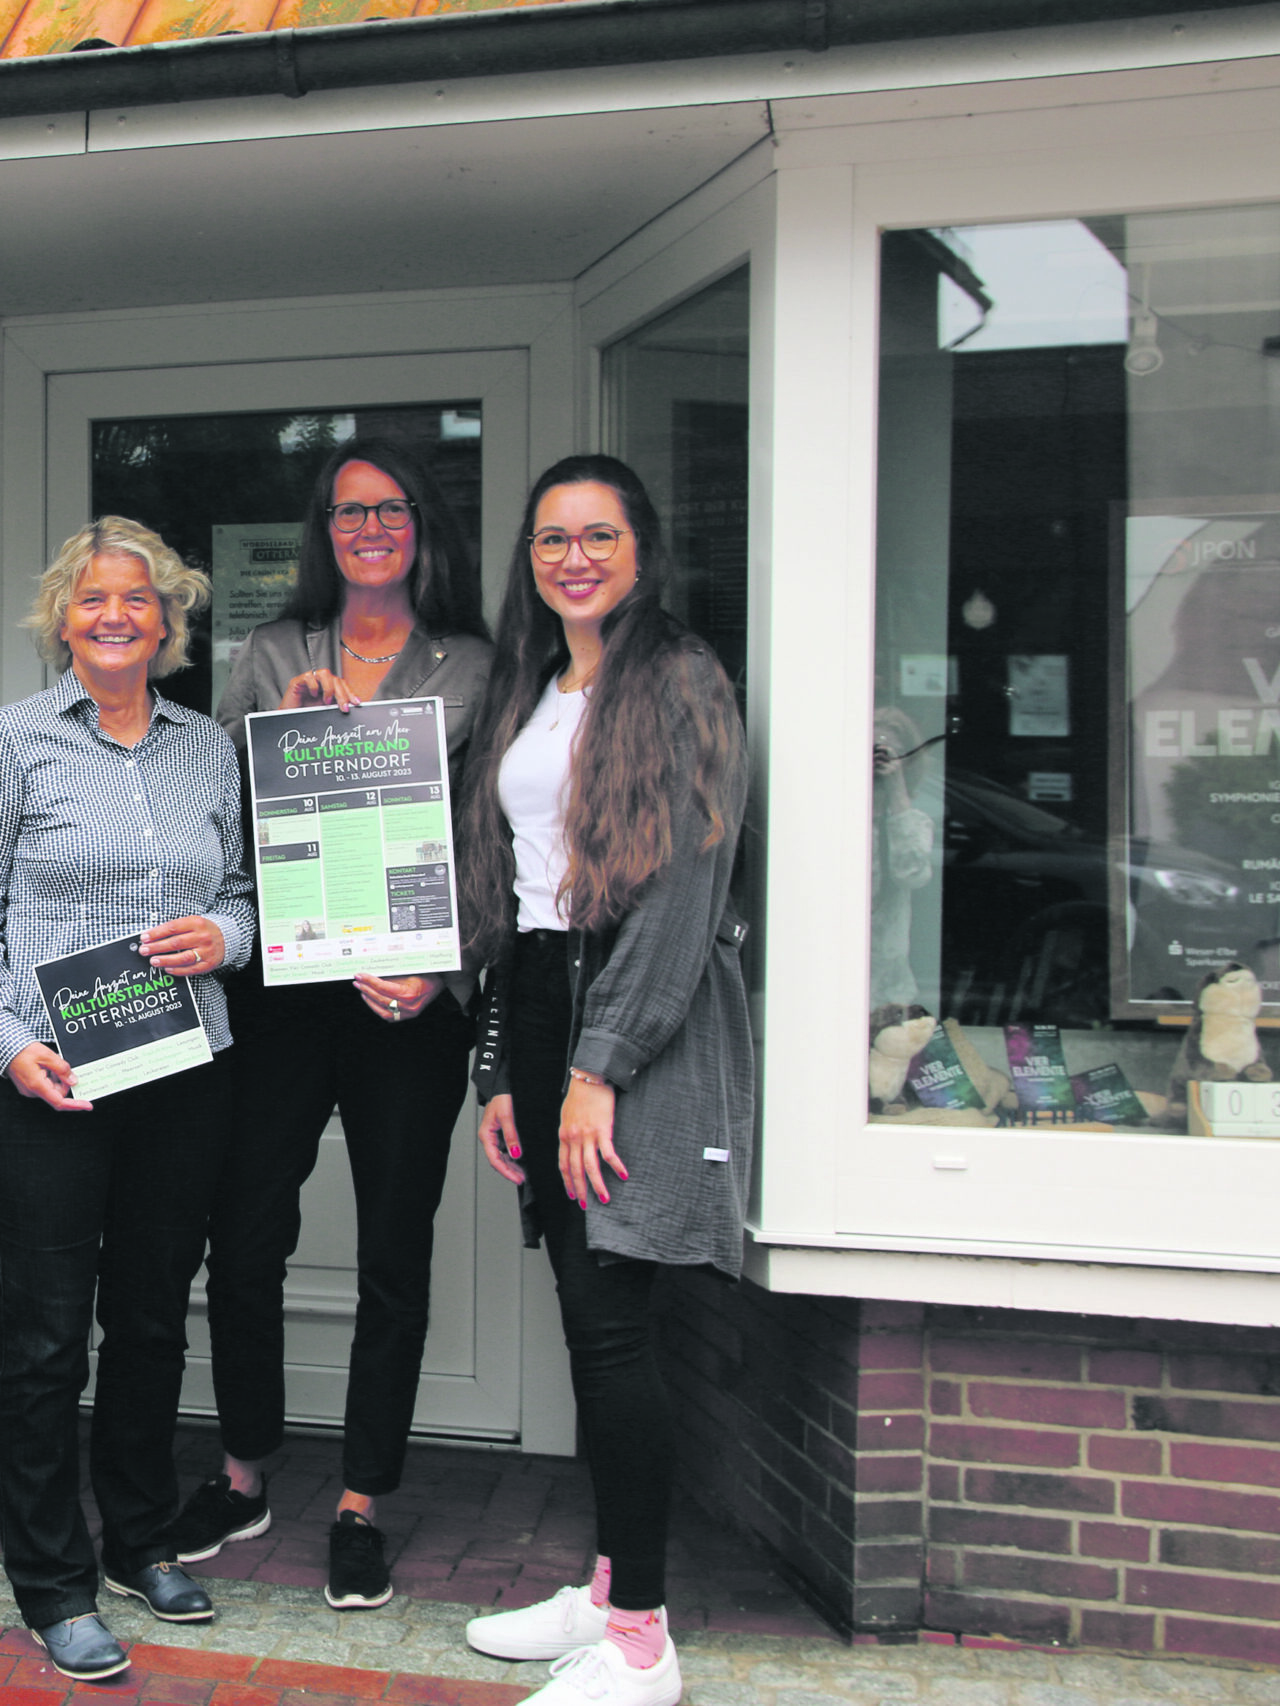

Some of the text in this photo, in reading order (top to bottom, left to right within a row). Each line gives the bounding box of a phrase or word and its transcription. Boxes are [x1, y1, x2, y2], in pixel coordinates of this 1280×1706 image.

[229, 590, 254, 598] Sollten
[256, 590, 268, 598] Sie
[278, 728, 318, 754] Deine
[320, 724, 365, 750] Auszeit
[284, 738, 410, 764] KULTURSTRAND
[285, 753, 412, 779] OTTERNDORF
[336, 774, 346, 782] 10.
[351, 772, 360, 780] 13.
[362, 769, 392, 780] AUGUST
[393, 768, 412, 777] 2023
[366, 792, 376, 800] 12
[429, 786, 440, 794] 13
[303, 799, 314, 807] 10
[259, 808, 298, 817] DONNERSTAG
[307, 844, 317, 852] 11
[52, 986, 90, 1010] Deine
[93, 970, 131, 1000] Auszeit
[60, 974, 174, 1020] KULTURSTRAND
[65, 987, 179, 1034] OTTERNDORF
[114, 1020, 124, 1029] 10.
[129, 1016, 138, 1026] 13.
[137, 1006, 165, 1022] AUGUST
[165, 1002, 183, 1012] 2023
[920, 1060, 945, 1076] VIER
[1024, 1056, 1050, 1067] VIER
[912, 1064, 964, 1090] ELEMENTE
[1013, 1066, 1066, 1077] ELEMENTE
[1228, 1090, 1243, 1116] 0
